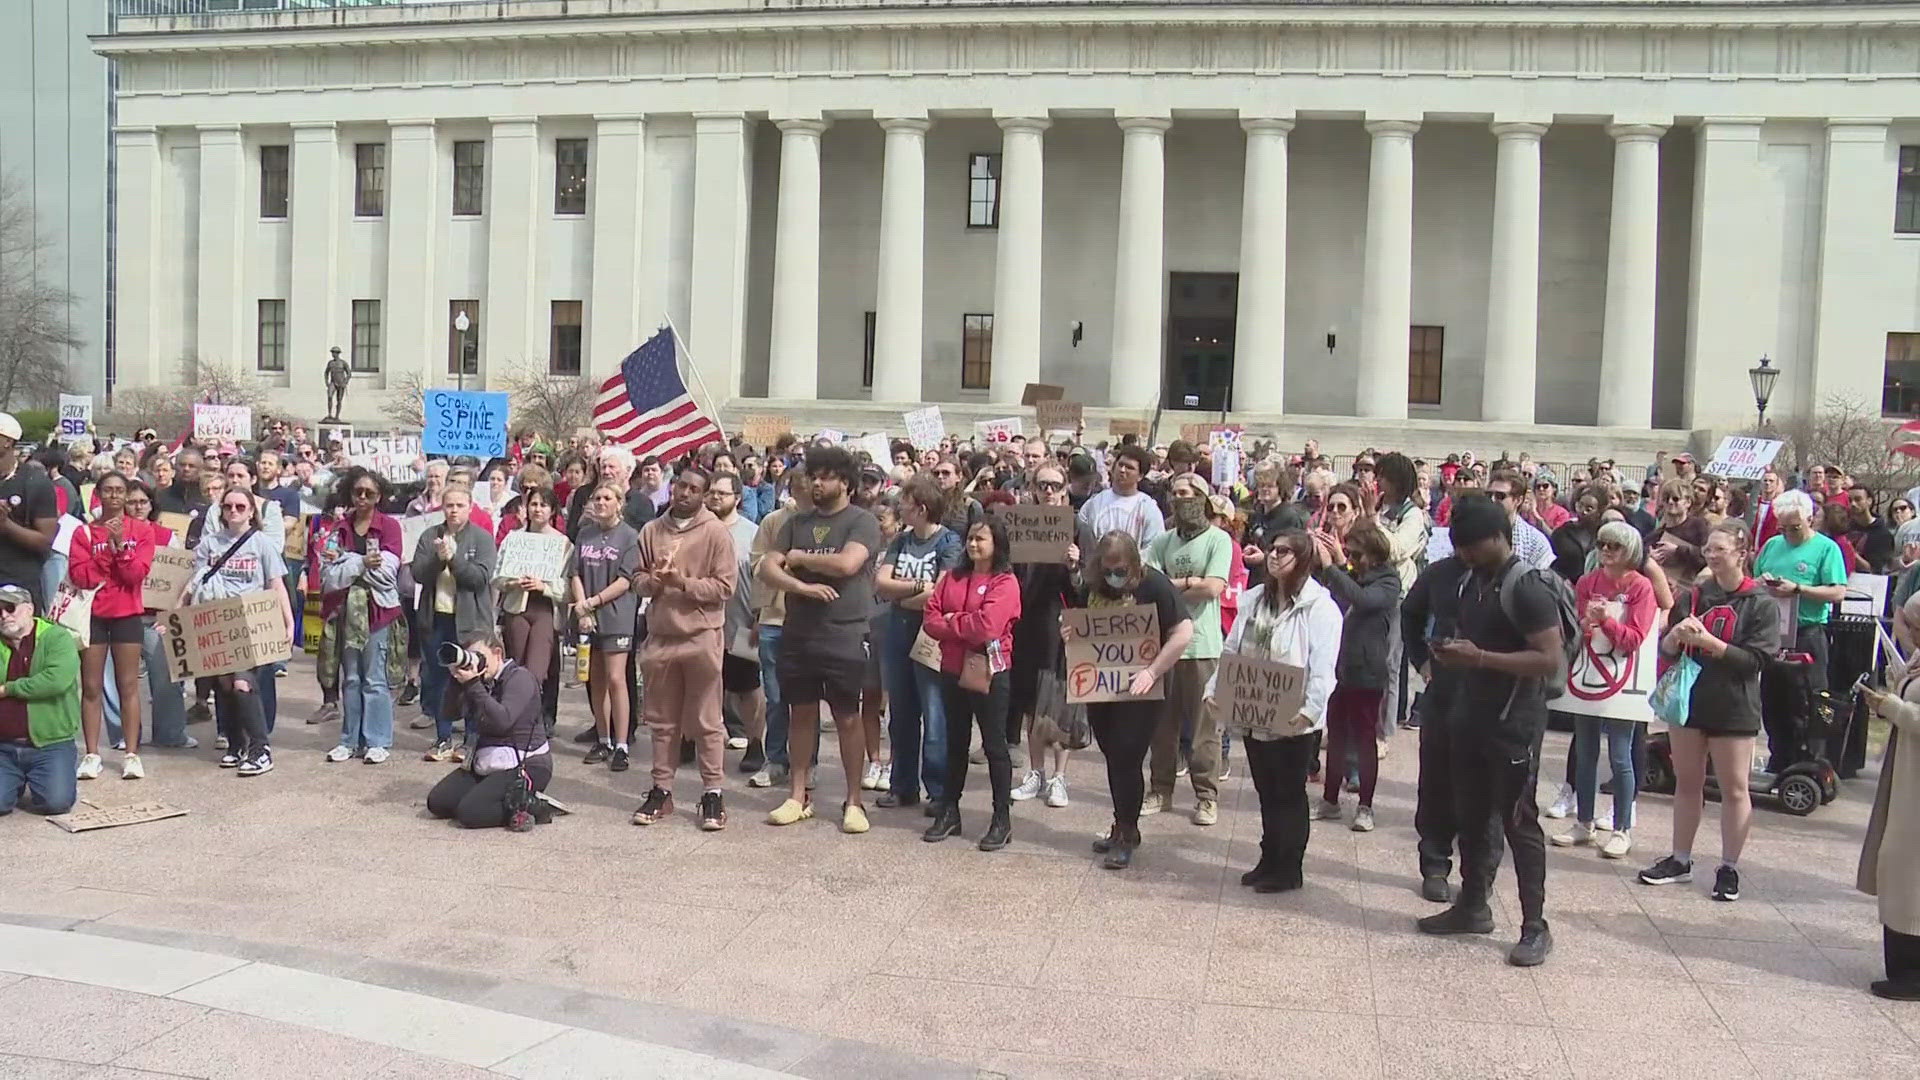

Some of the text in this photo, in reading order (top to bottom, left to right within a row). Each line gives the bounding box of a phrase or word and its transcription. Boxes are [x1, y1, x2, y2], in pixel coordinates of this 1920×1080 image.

[441, 409, 494, 430] SPINE
[348, 438, 419, 456] LISTEN
[438, 431, 461, 442] GOV
[1729, 450, 1757, 465] GAG
[1709, 462, 1766, 479] SPECH
[227, 557, 258, 570] STATE
[192, 600, 279, 628] ANTI-EDUCATION
[197, 622, 273, 650] ANTI-GROWTH
[1092, 642, 1134, 664] YOU
[1227, 661, 1294, 691] CAN YOU
[1232, 701, 1278, 726] NOW?
